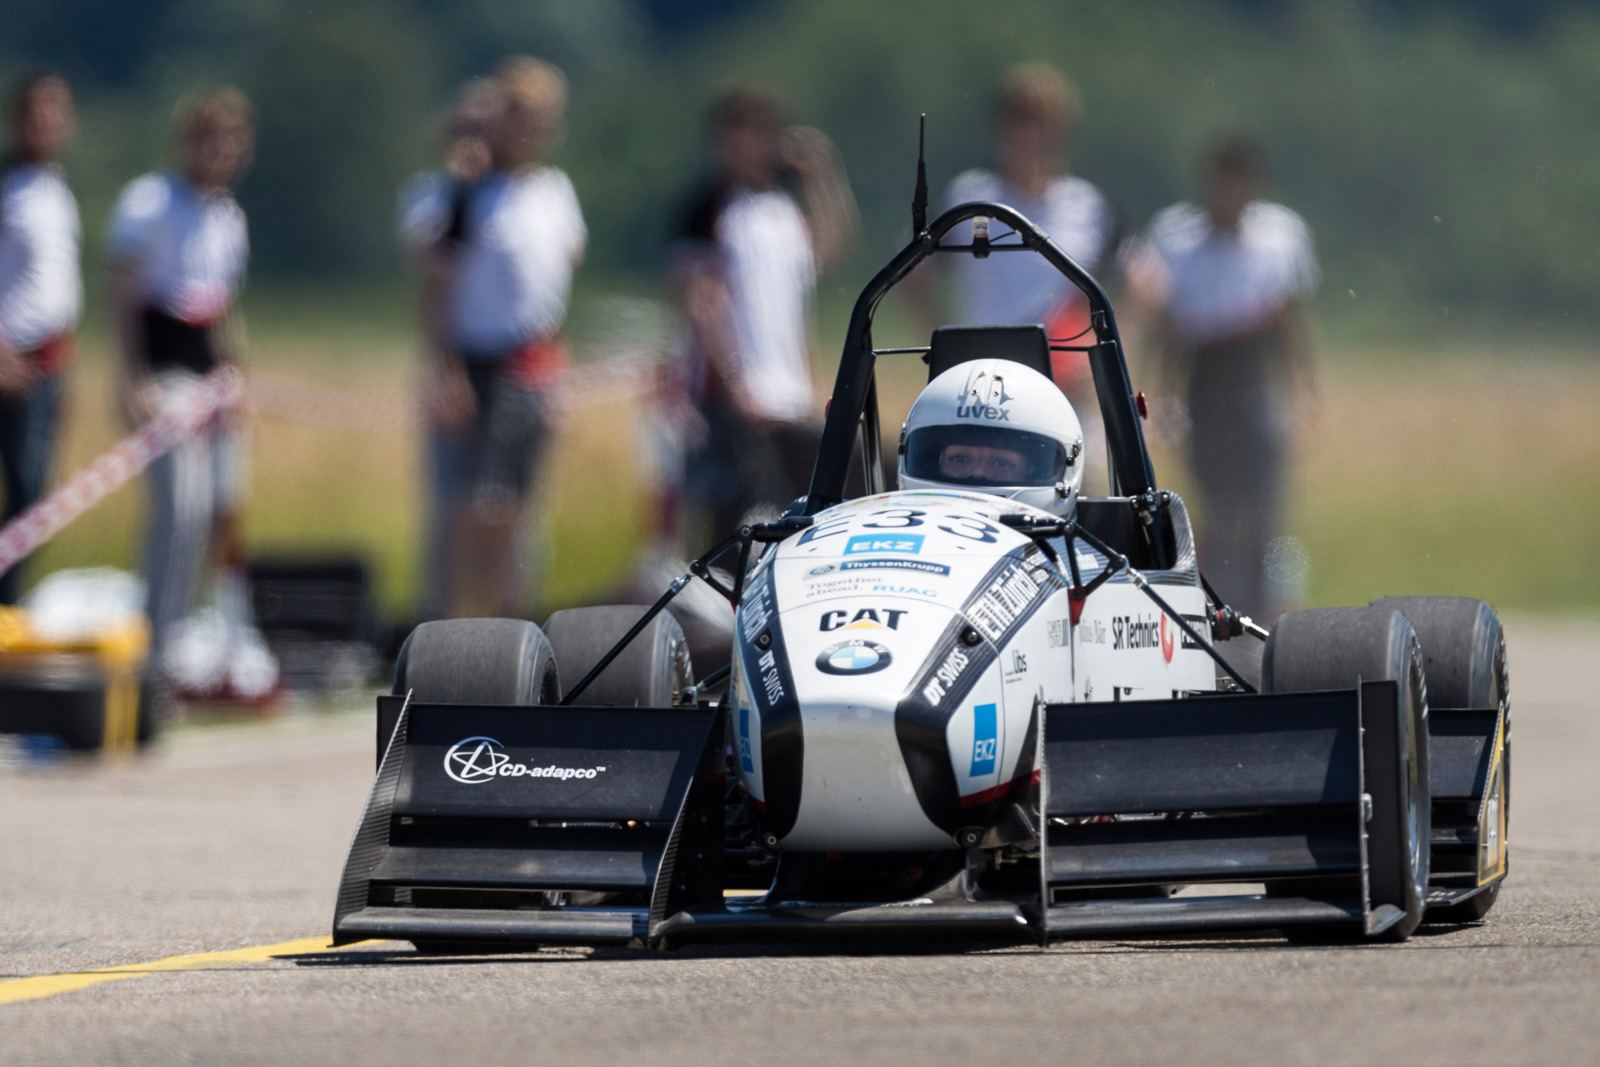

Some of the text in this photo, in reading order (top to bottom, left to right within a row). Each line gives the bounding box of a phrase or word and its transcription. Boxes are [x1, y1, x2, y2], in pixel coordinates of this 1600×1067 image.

[956, 405, 1011, 422] uvex
[851, 540, 915, 552] EKZ
[846, 559, 945, 574] ThyssenKrupp
[806, 584, 864, 598] ahead.
[807, 576, 885, 591] Together
[873, 584, 937, 598] RUAG
[819, 608, 909, 632] CAT
[1112, 616, 1124, 650] SR
[1125, 613, 1160, 649] Technics
[922, 647, 970, 707] DT SWISS
[763, 669, 785, 706] SWISS
[974, 738, 996, 763] EKZ
